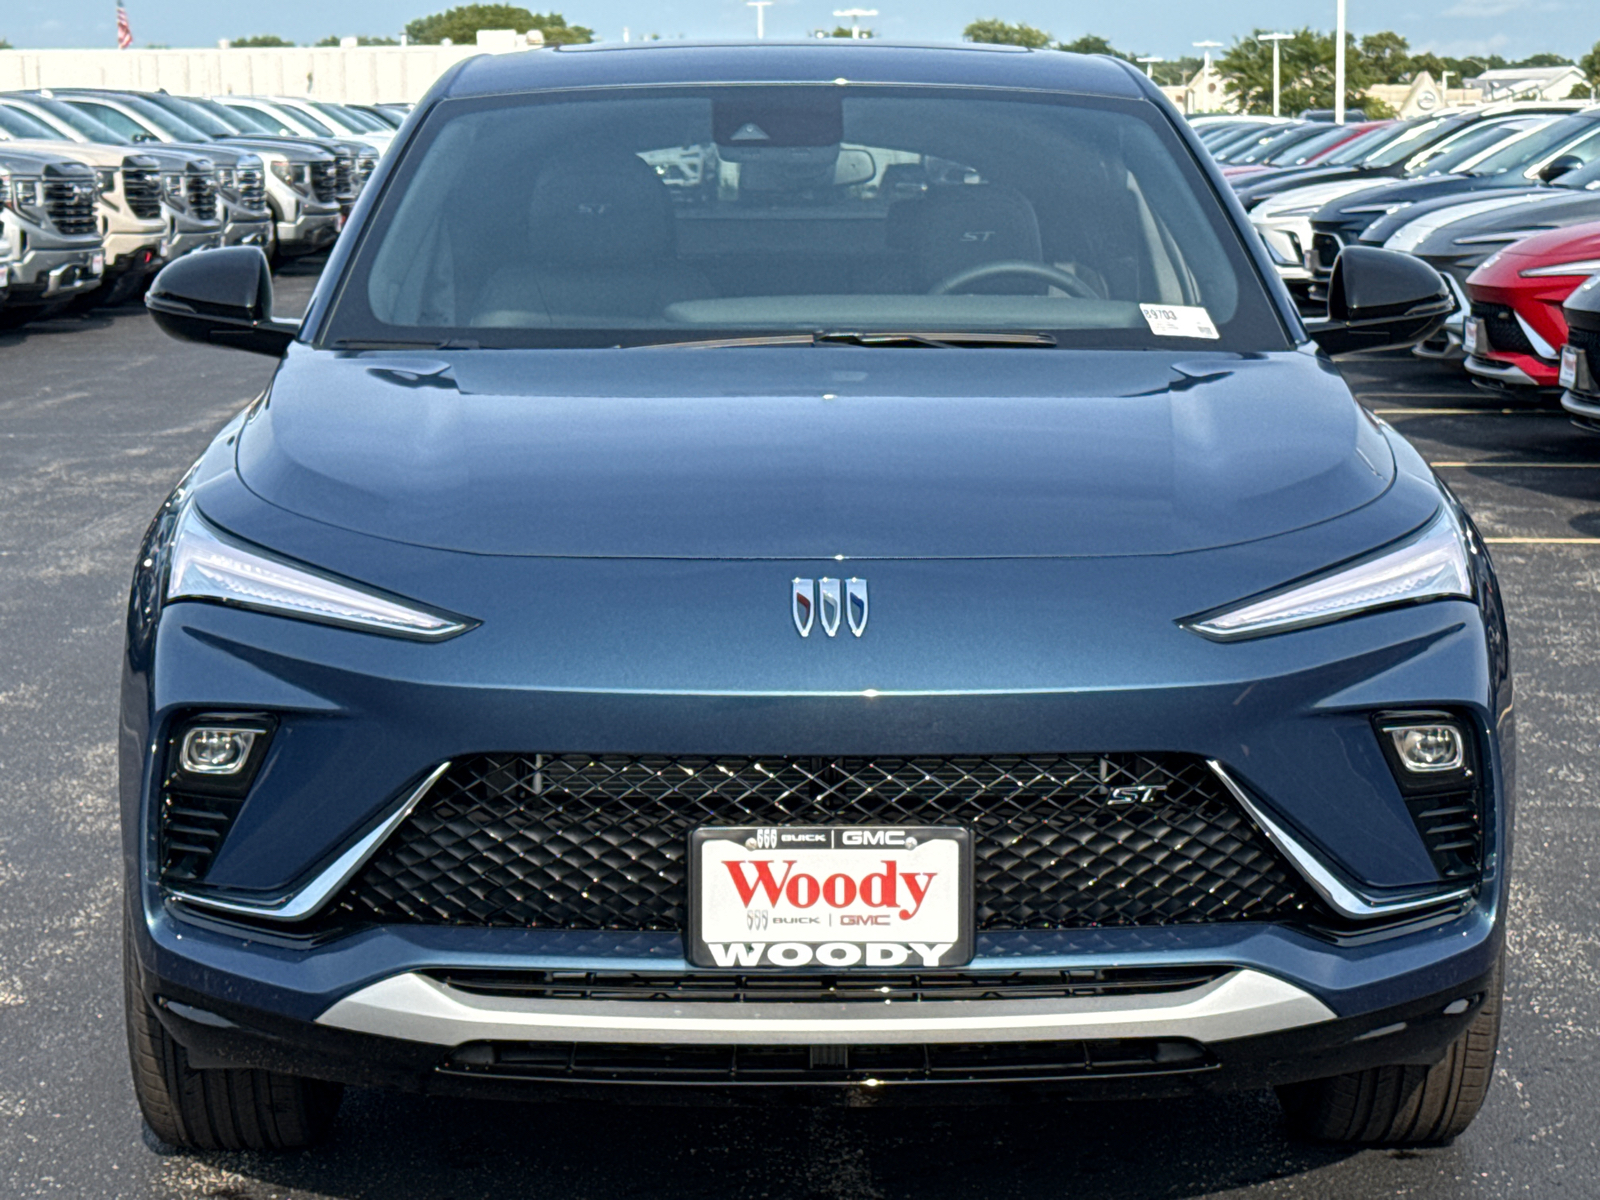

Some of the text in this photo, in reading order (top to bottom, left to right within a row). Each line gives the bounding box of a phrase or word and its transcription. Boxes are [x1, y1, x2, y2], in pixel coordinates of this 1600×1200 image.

[959, 231, 994, 242] ST
[1107, 785, 1168, 805] ST
[781, 830, 906, 846] BUICK GMC
[721, 860, 938, 921] Woody
[772, 914, 891, 926] BUICK GMC
[708, 942, 954, 967] WOODY
